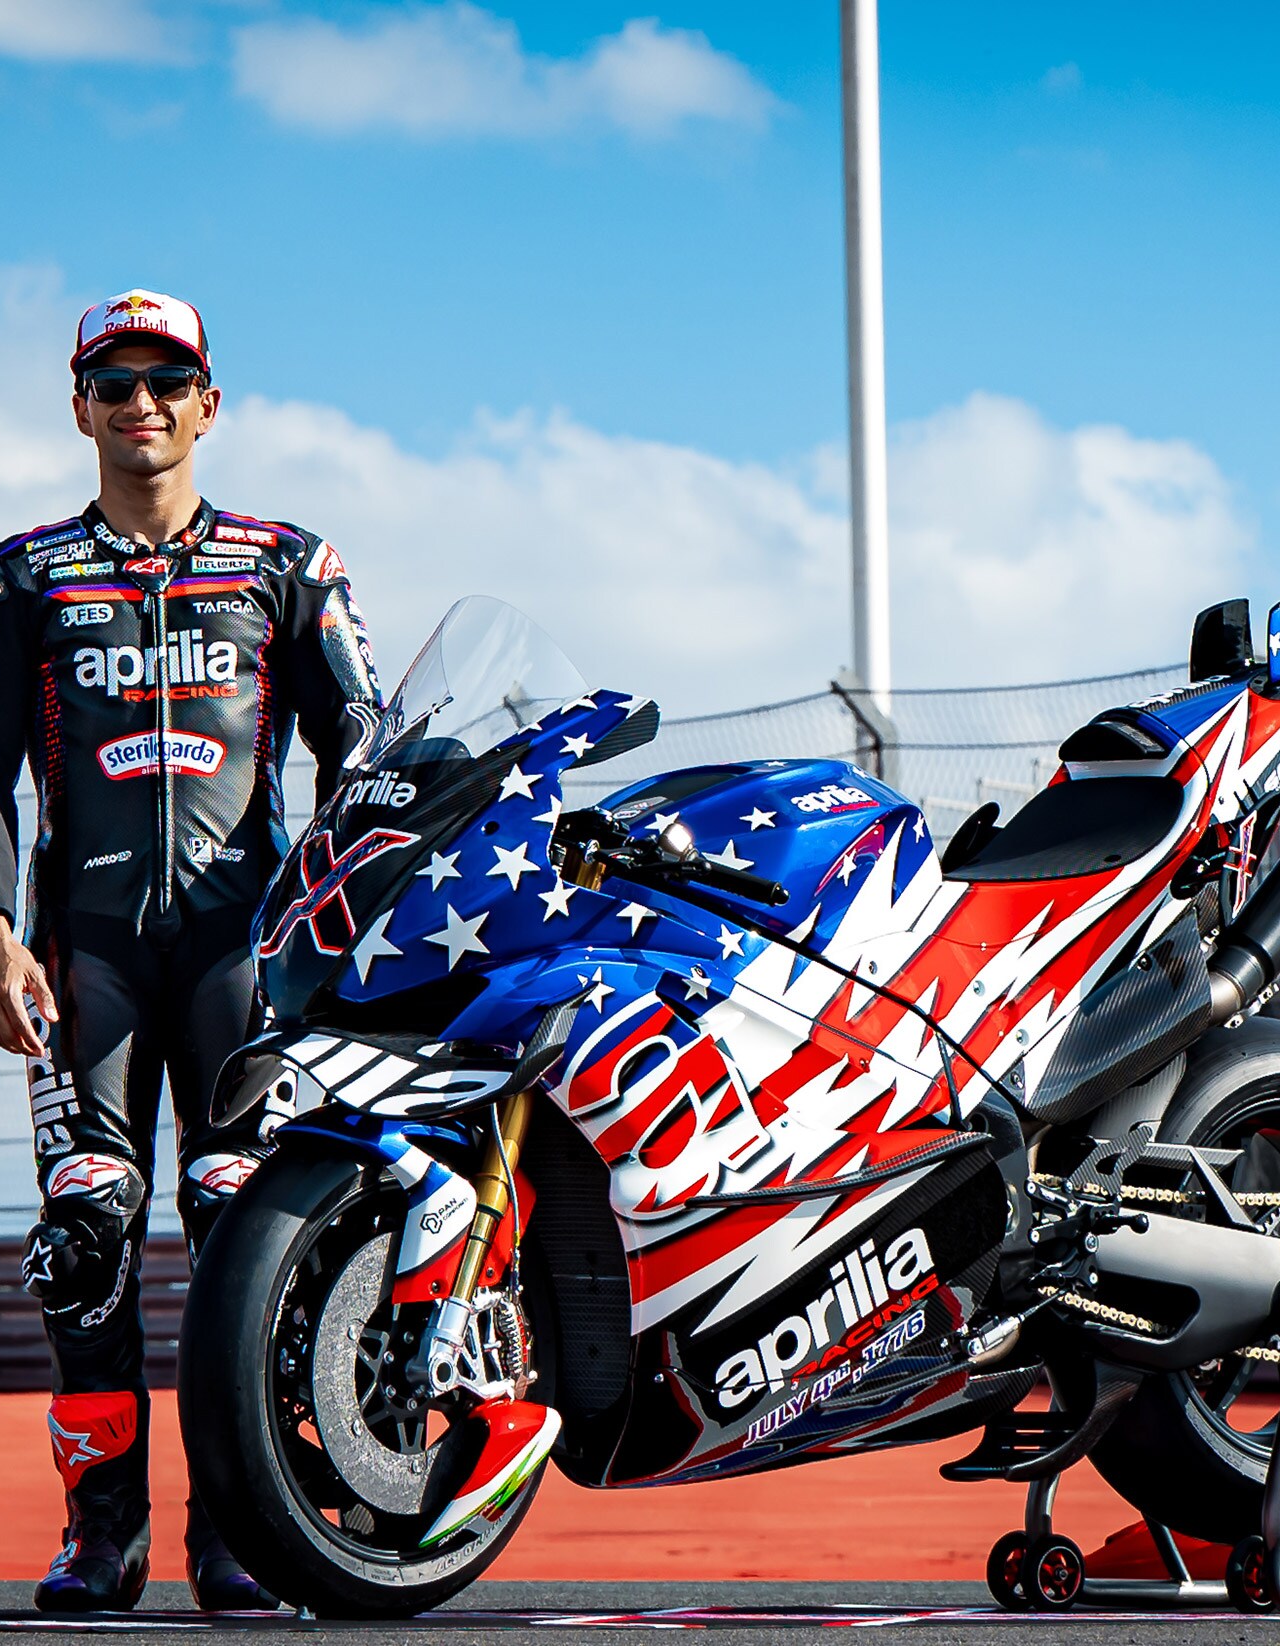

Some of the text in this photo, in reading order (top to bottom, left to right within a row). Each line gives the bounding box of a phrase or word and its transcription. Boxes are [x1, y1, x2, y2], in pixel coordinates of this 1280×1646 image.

[105, 316, 167, 333] Red Bull
[93, 521, 137, 554] aprilia
[193, 600, 255, 613] TARGA
[73, 628, 238, 696] aprilia
[438, 1198, 457, 1216] PAN
[715, 1227, 935, 1408] aprilia
[791, 1273, 940, 1385] RACING
[742, 1387, 809, 1448] JULY
[862, 1309, 926, 1373] 1776
